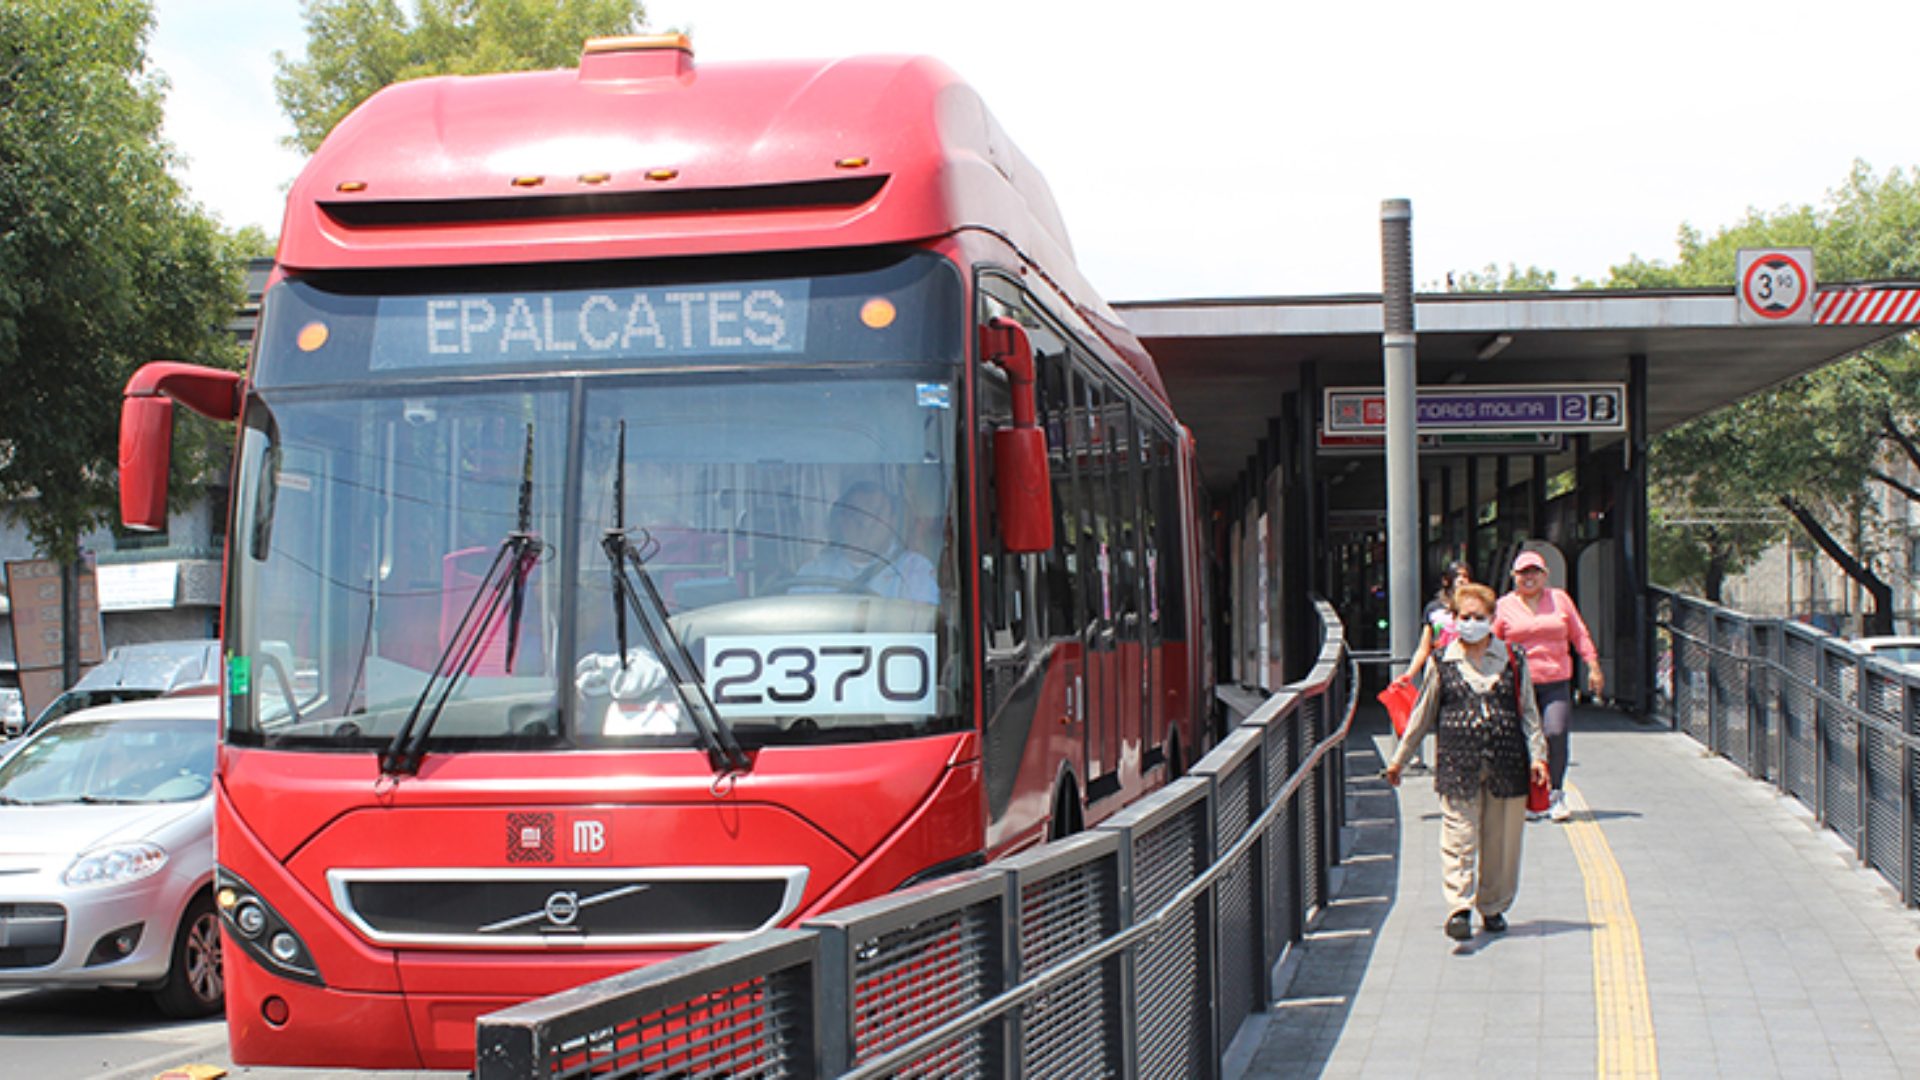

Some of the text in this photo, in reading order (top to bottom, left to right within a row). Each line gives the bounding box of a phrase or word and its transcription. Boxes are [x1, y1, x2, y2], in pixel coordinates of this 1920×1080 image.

[426, 290, 787, 354] EPALCATES
[1417, 401, 1477, 419] NDRES
[1479, 400, 1545, 418] MOLINA
[1564, 397, 1583, 417] 2
[712, 645, 930, 704] 2370
[573, 820, 606, 853] MB
